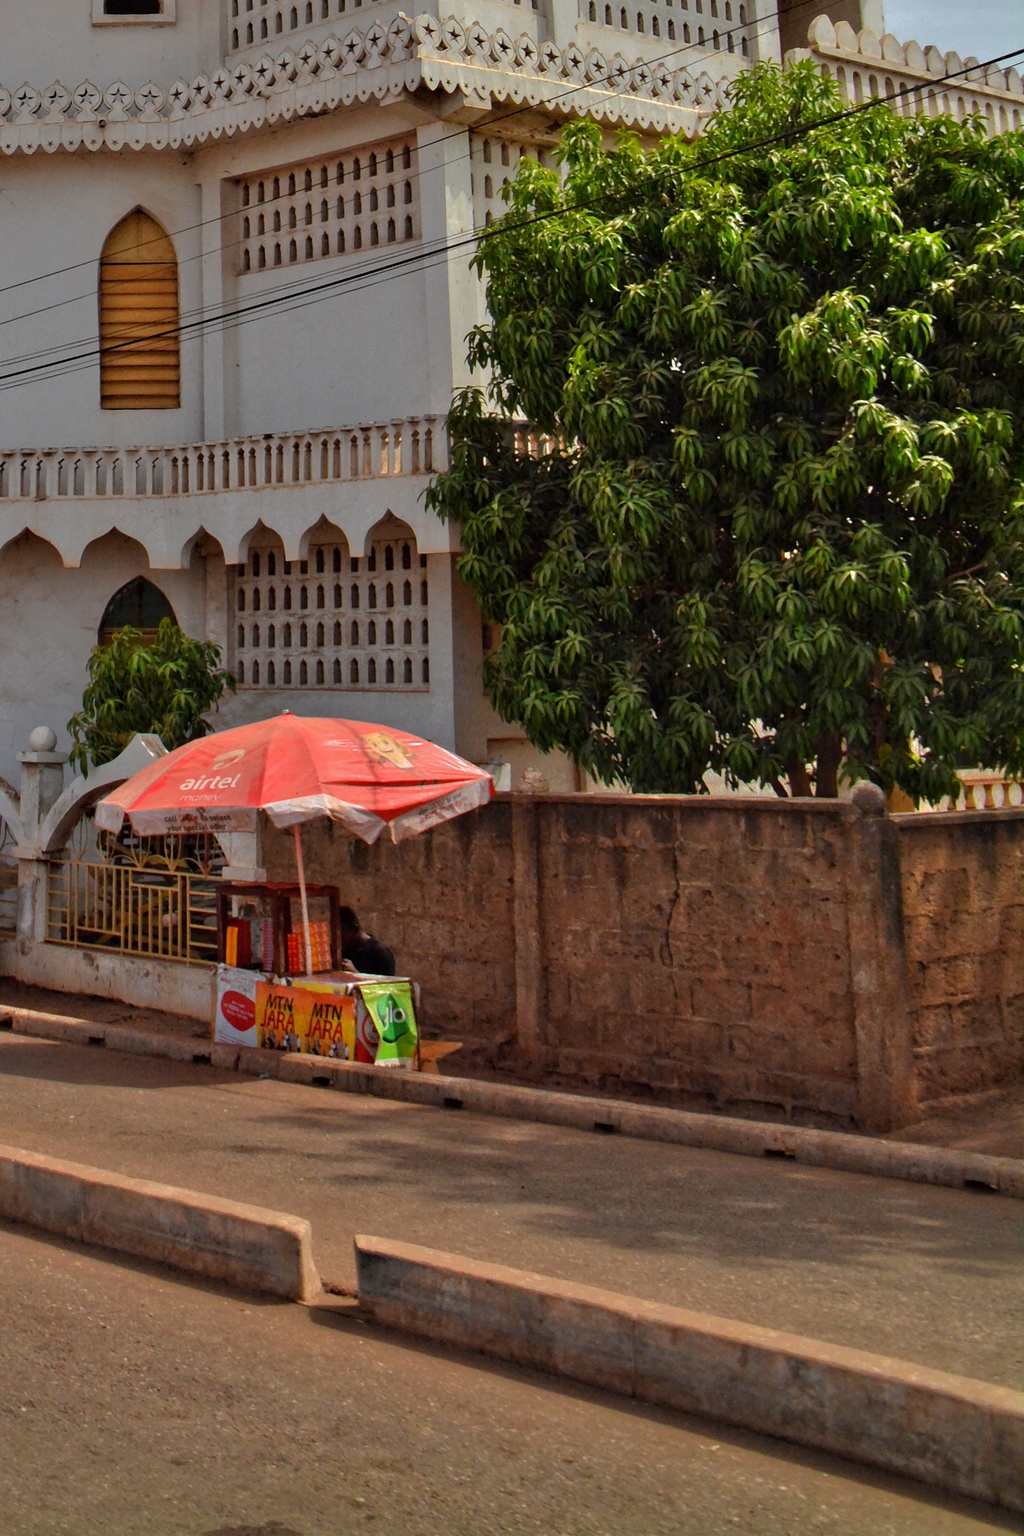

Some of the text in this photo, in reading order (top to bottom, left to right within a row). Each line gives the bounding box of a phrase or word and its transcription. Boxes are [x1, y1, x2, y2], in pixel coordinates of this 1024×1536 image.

[179, 773, 242, 791] airtel
[179, 793, 223, 802] money
[164, 814, 178, 823] call
[209, 814, 232, 822] select
[166, 823, 227, 834] your special offer
[266, 993, 294, 1012] MTN
[311, 1002, 343, 1021] MTN
[260, 1008, 296, 1035] JARA
[304, 1018, 344, 1044] JARA
